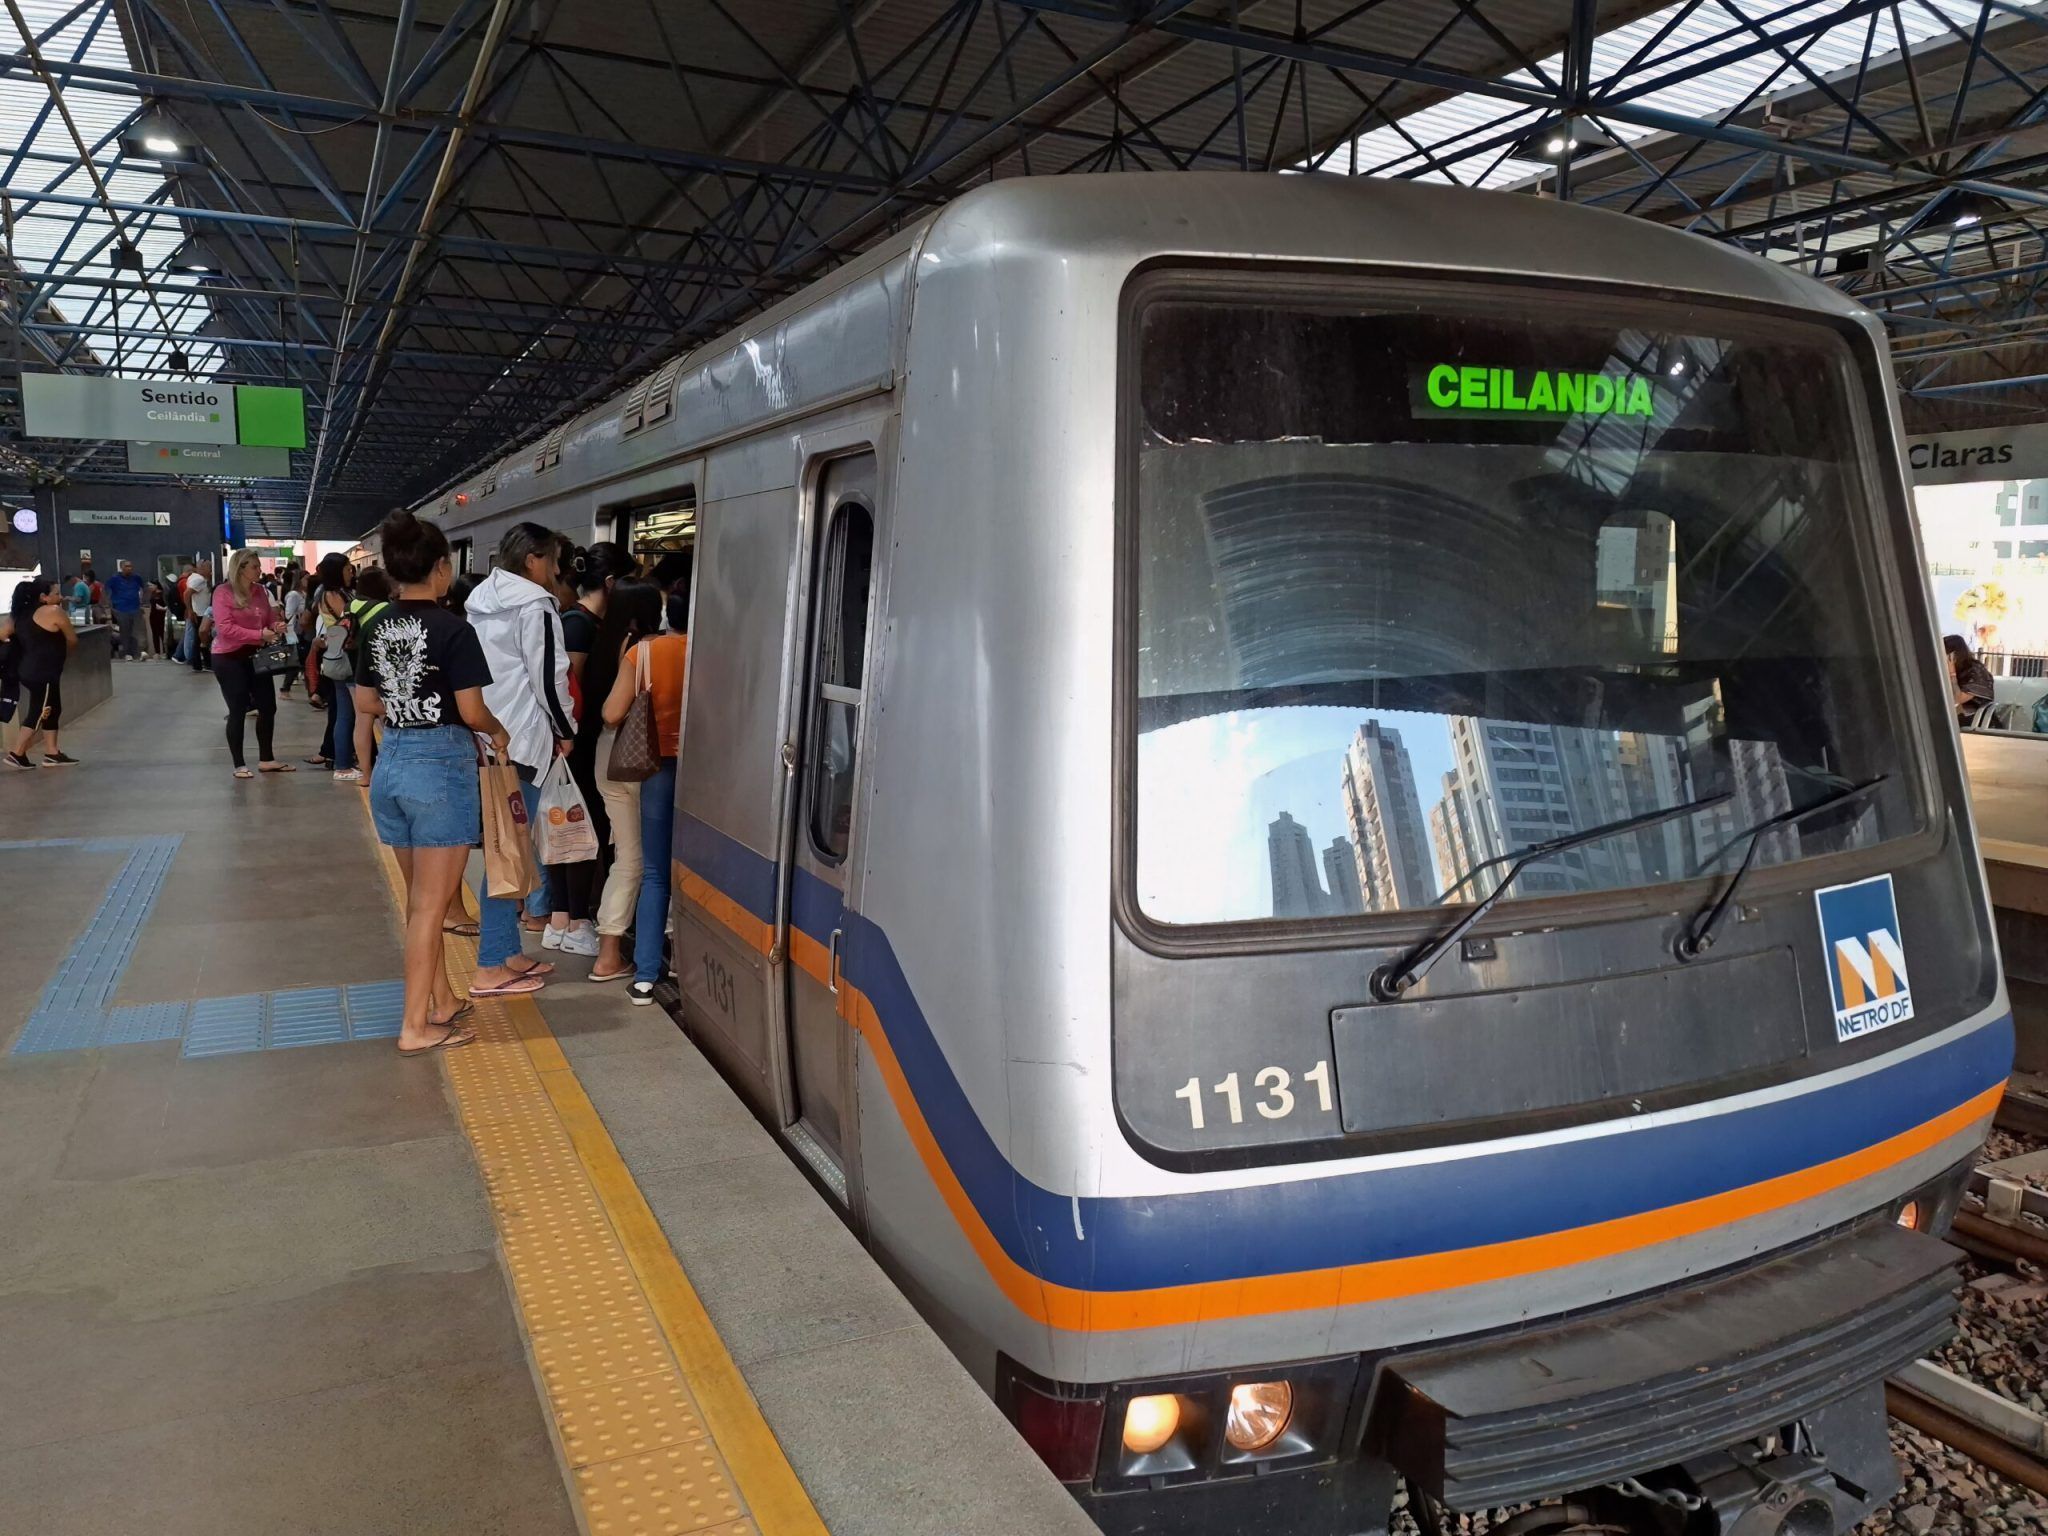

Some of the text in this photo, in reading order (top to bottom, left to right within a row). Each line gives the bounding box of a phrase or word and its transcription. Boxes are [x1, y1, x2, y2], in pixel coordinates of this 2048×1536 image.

[141, 388, 218, 406] Sentido
[1427, 363, 1654, 416] CEILANDIA
[147, 410, 206, 422] Ceilândia
[183, 448, 221, 458] Central
[1908, 442, 2013, 470] Claras
[702, 951, 737, 1022] 1131
[1175, 1060, 1333, 1129] 1131
